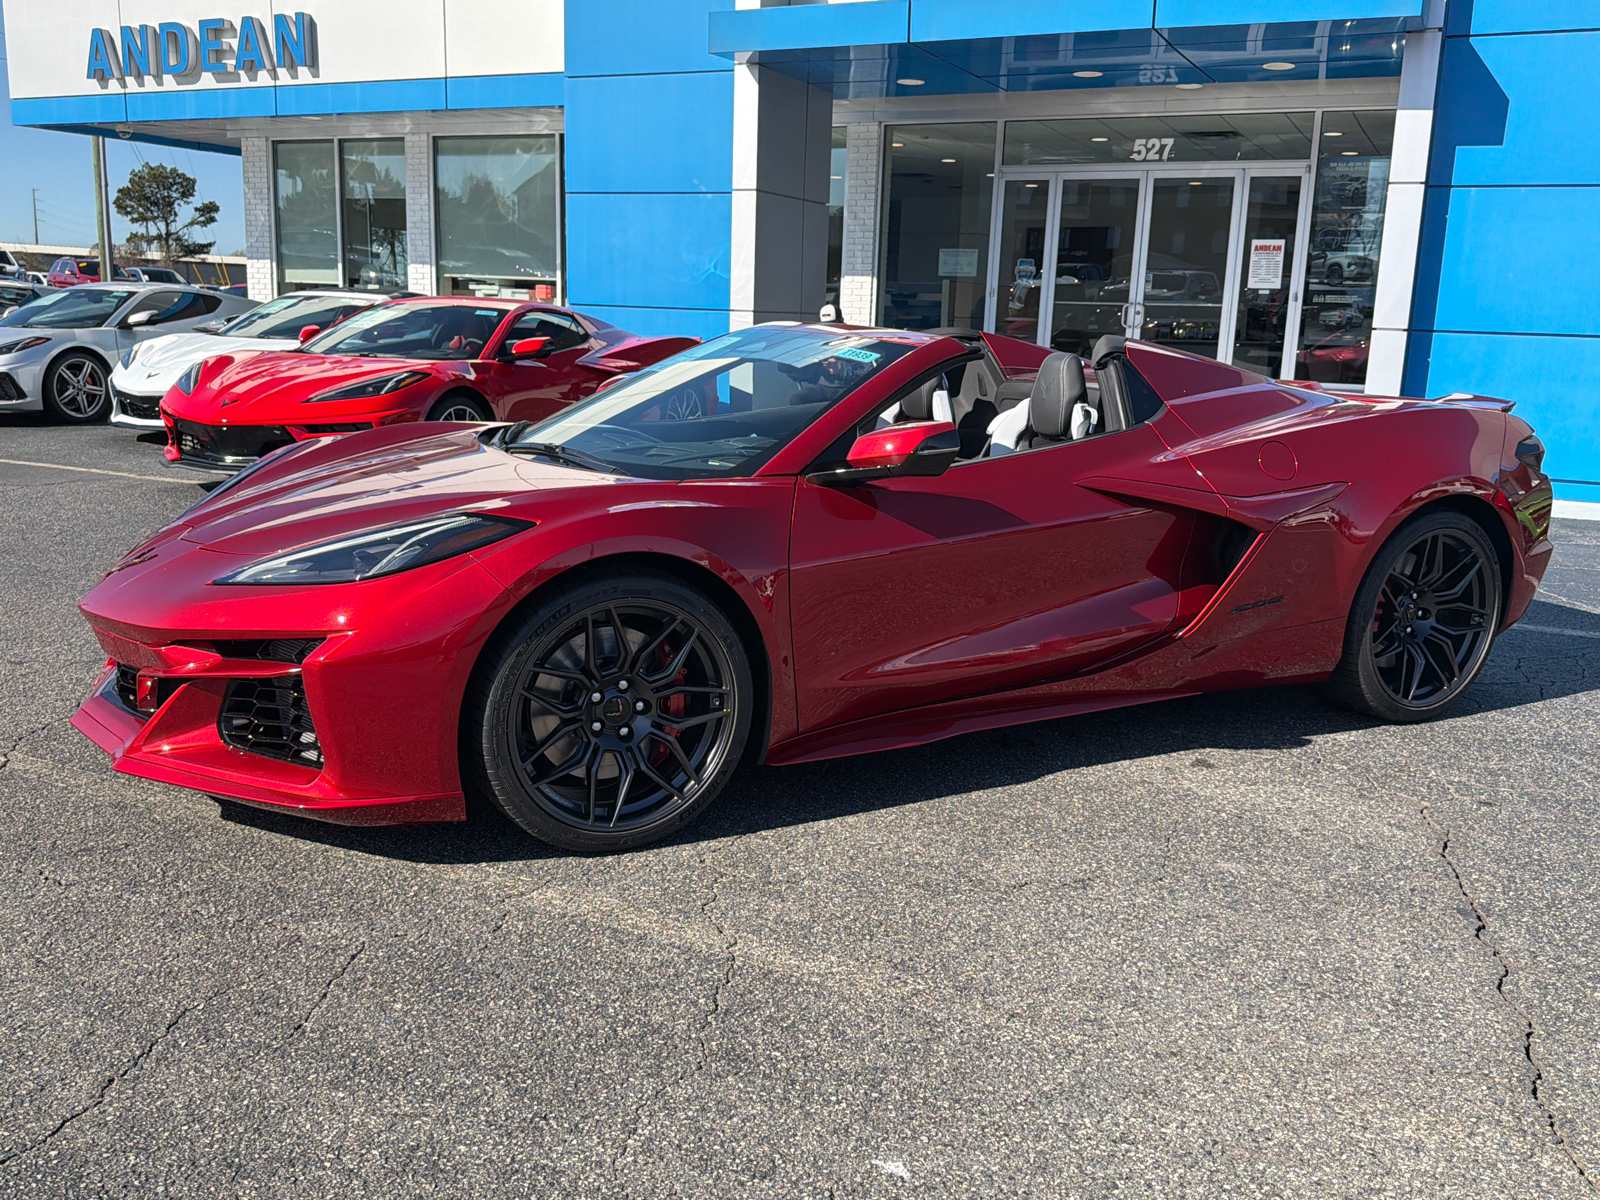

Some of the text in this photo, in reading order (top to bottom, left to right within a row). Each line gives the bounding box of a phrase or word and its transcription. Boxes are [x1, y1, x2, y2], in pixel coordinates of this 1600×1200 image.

[86, 12, 315, 80] ANDEAN
[1132, 137, 1175, 161] 527
[1253, 244, 1282, 252] ANDEAN
[842, 349, 873, 360] T1939
